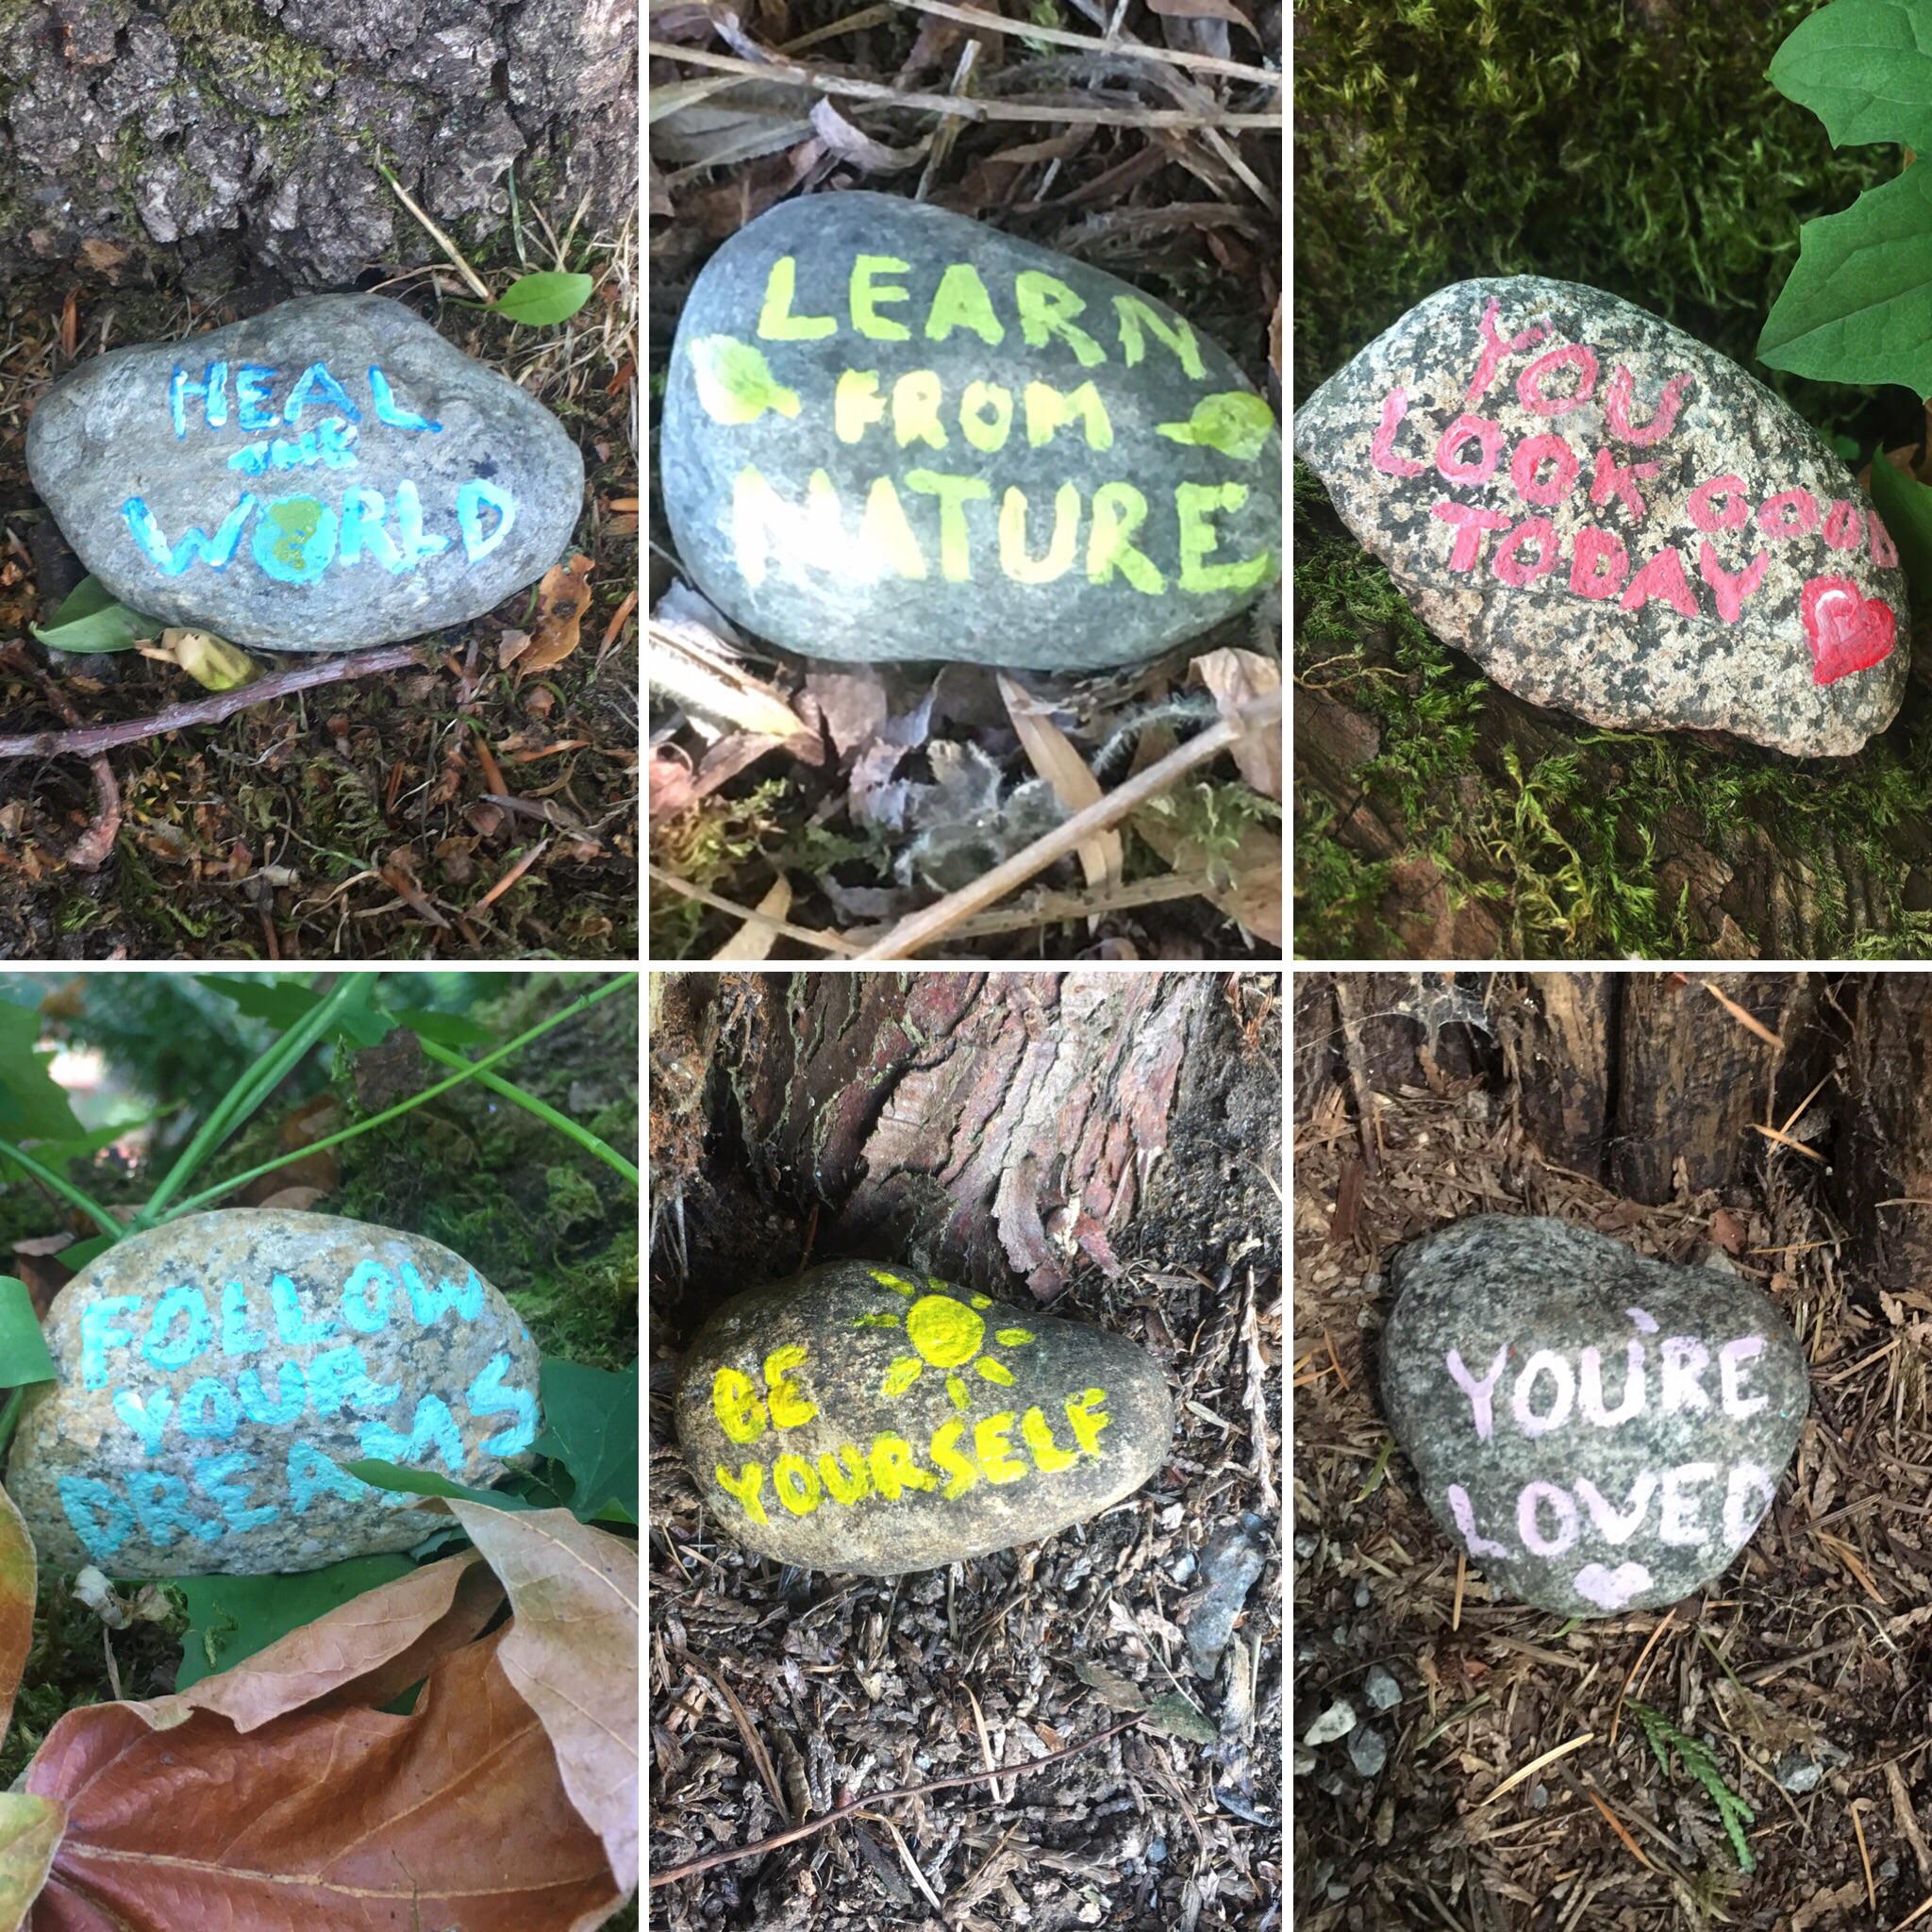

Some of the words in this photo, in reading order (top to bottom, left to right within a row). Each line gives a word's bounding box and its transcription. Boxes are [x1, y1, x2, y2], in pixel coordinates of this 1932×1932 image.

[758, 254, 1207, 379] LEARN
[1465, 296, 1691, 446] YOU
[170, 360, 443, 439] HEAL
[226, 417, 359, 476] THE
[835, 369, 1114, 451] FROM
[121, 478, 516, 585] WORLD
[731, 466, 1272, 594] NATURE
[1370, 388, 1662, 520] LOOK
[1687, 474, 1899, 568] GOOD
[1430, 501, 1769, 623] TODAY
[79, 1258, 483, 1392] FOLLOW
[1446, 1307, 1768, 1441] YOU'RE
[112, 1344, 403, 1457] YOUR
[713, 1343, 820, 1443] BE
[715, 1388, 1111, 1525] YOURSELF
[1446, 1461, 1776, 1558] LOVED
